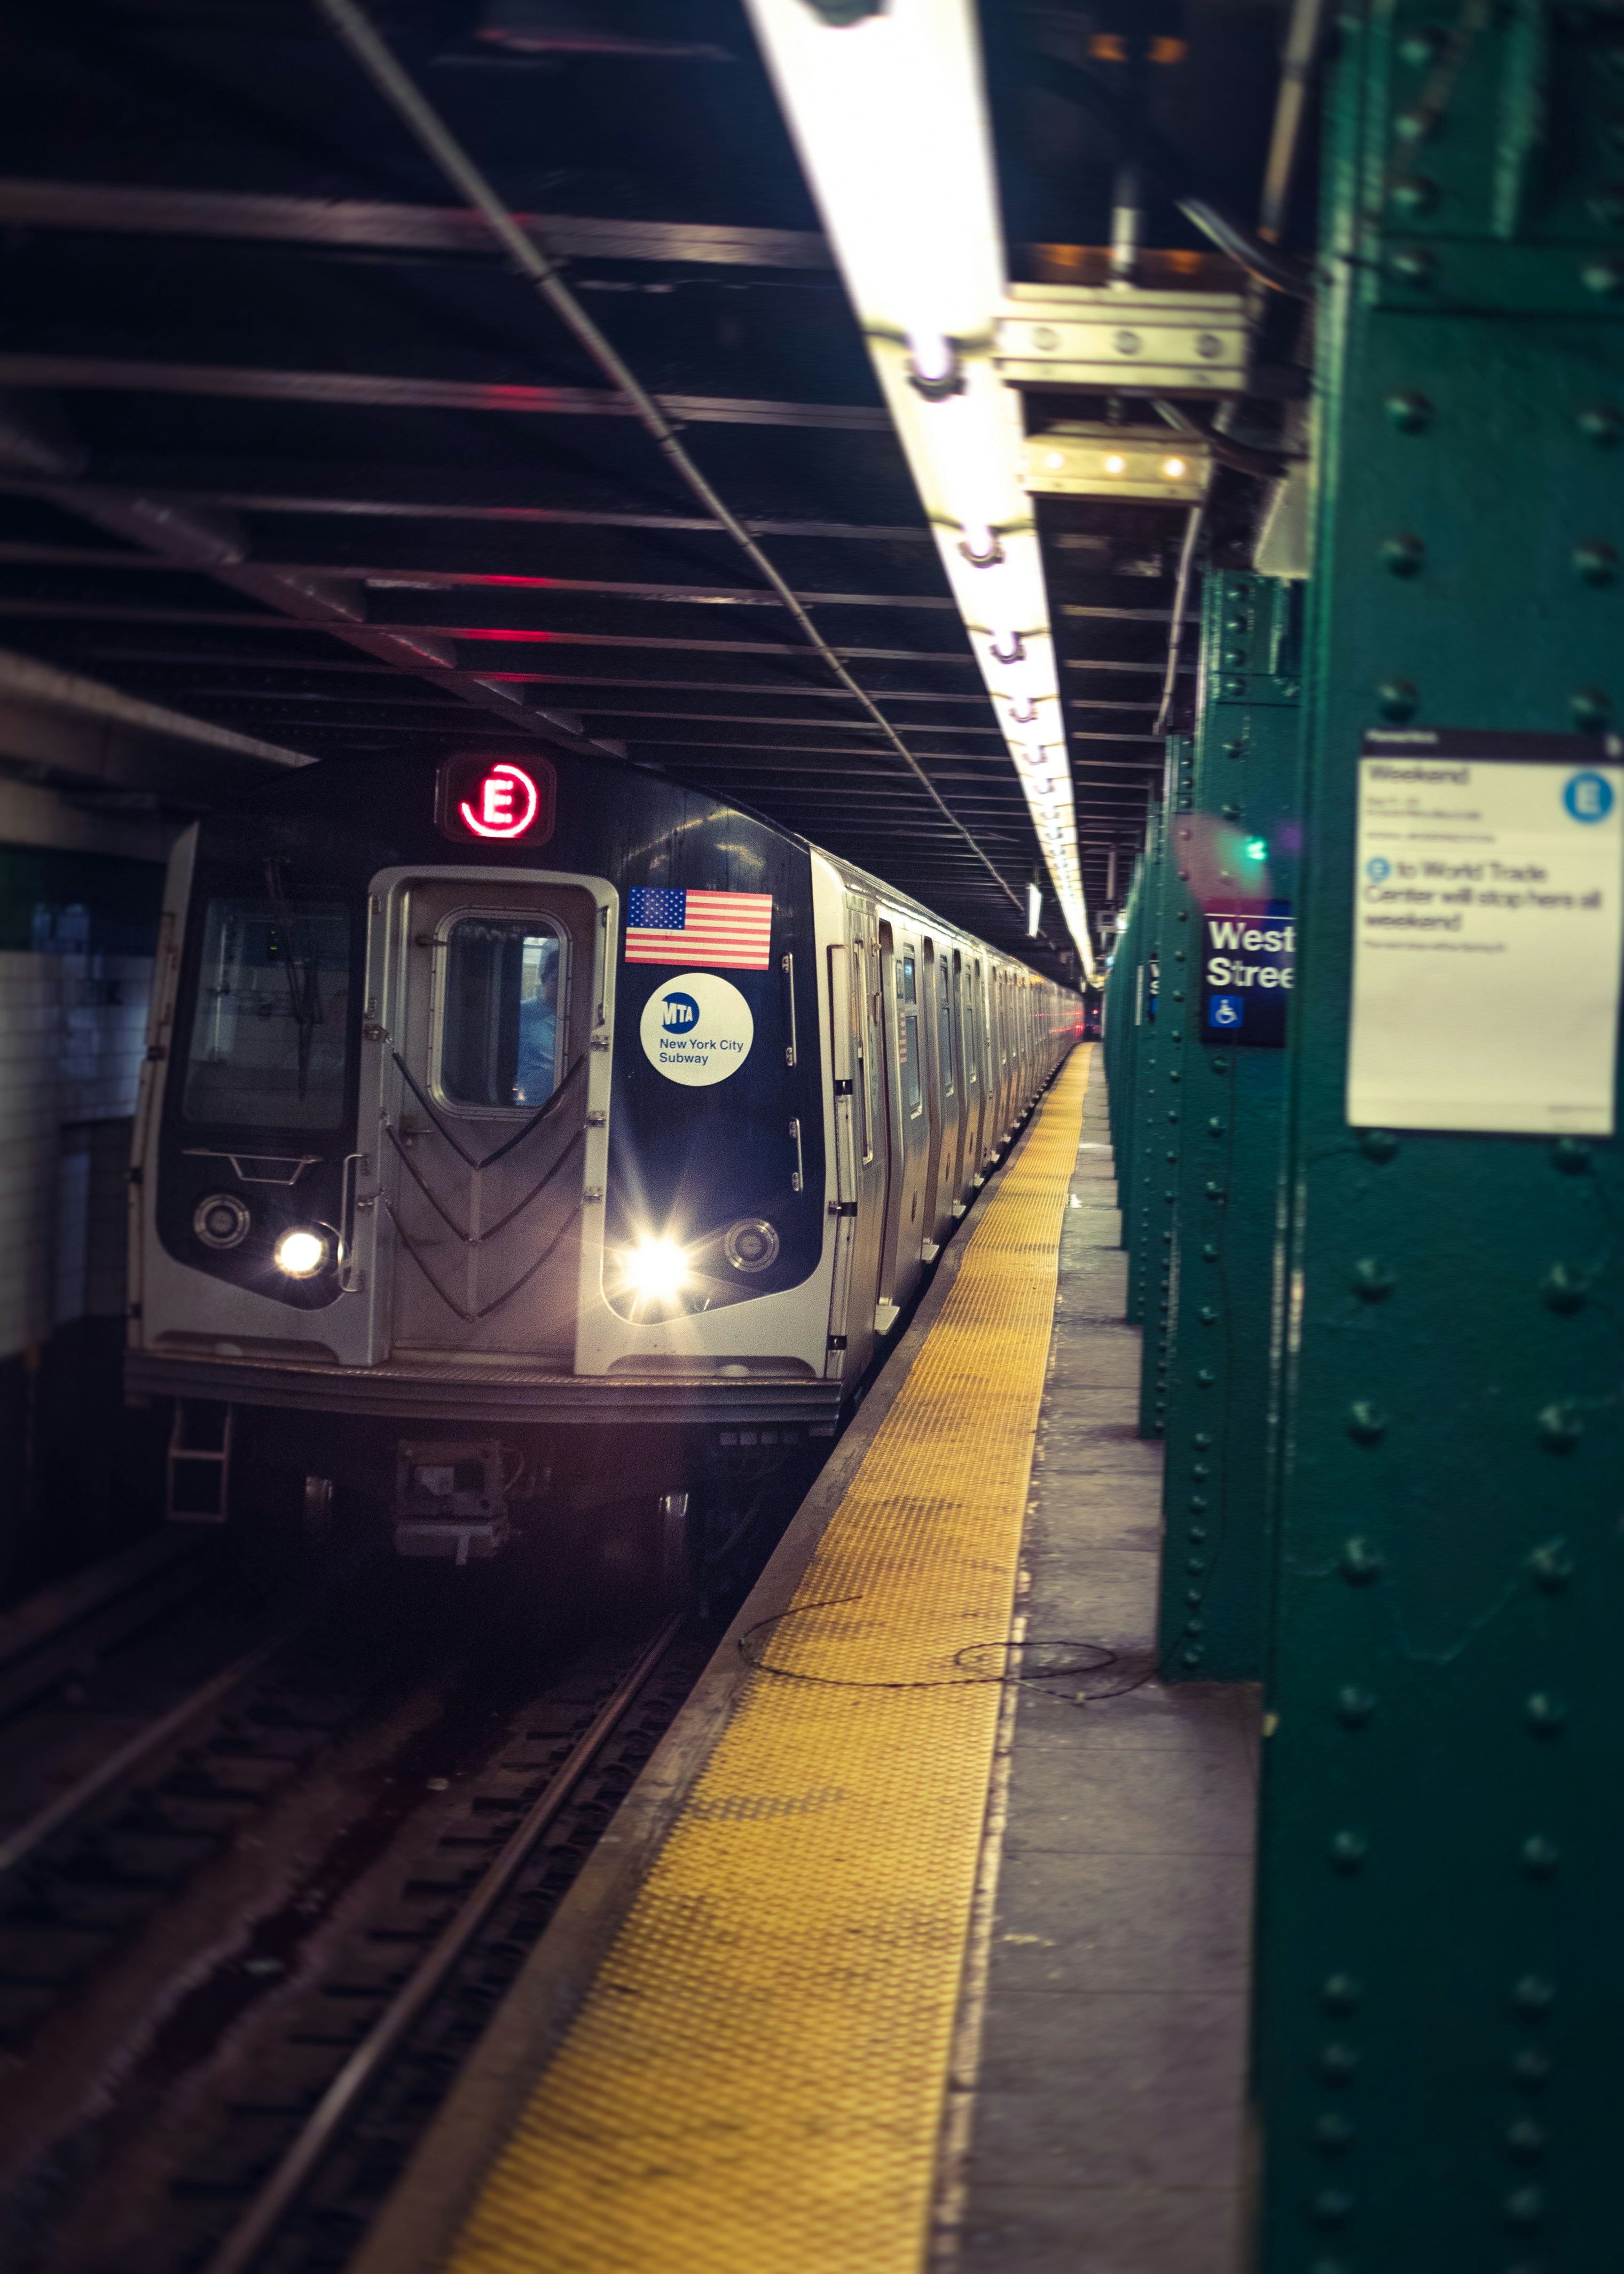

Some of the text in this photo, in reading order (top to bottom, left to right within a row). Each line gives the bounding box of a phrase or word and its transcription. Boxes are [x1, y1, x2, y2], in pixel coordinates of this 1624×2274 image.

[483, 779, 514, 823] E
[1208, 921, 1297, 952] West
[662, 1001, 693, 1025] MTA
[660, 1038, 744, 1053] New York City
[659, 1052, 709, 1066] Subway
